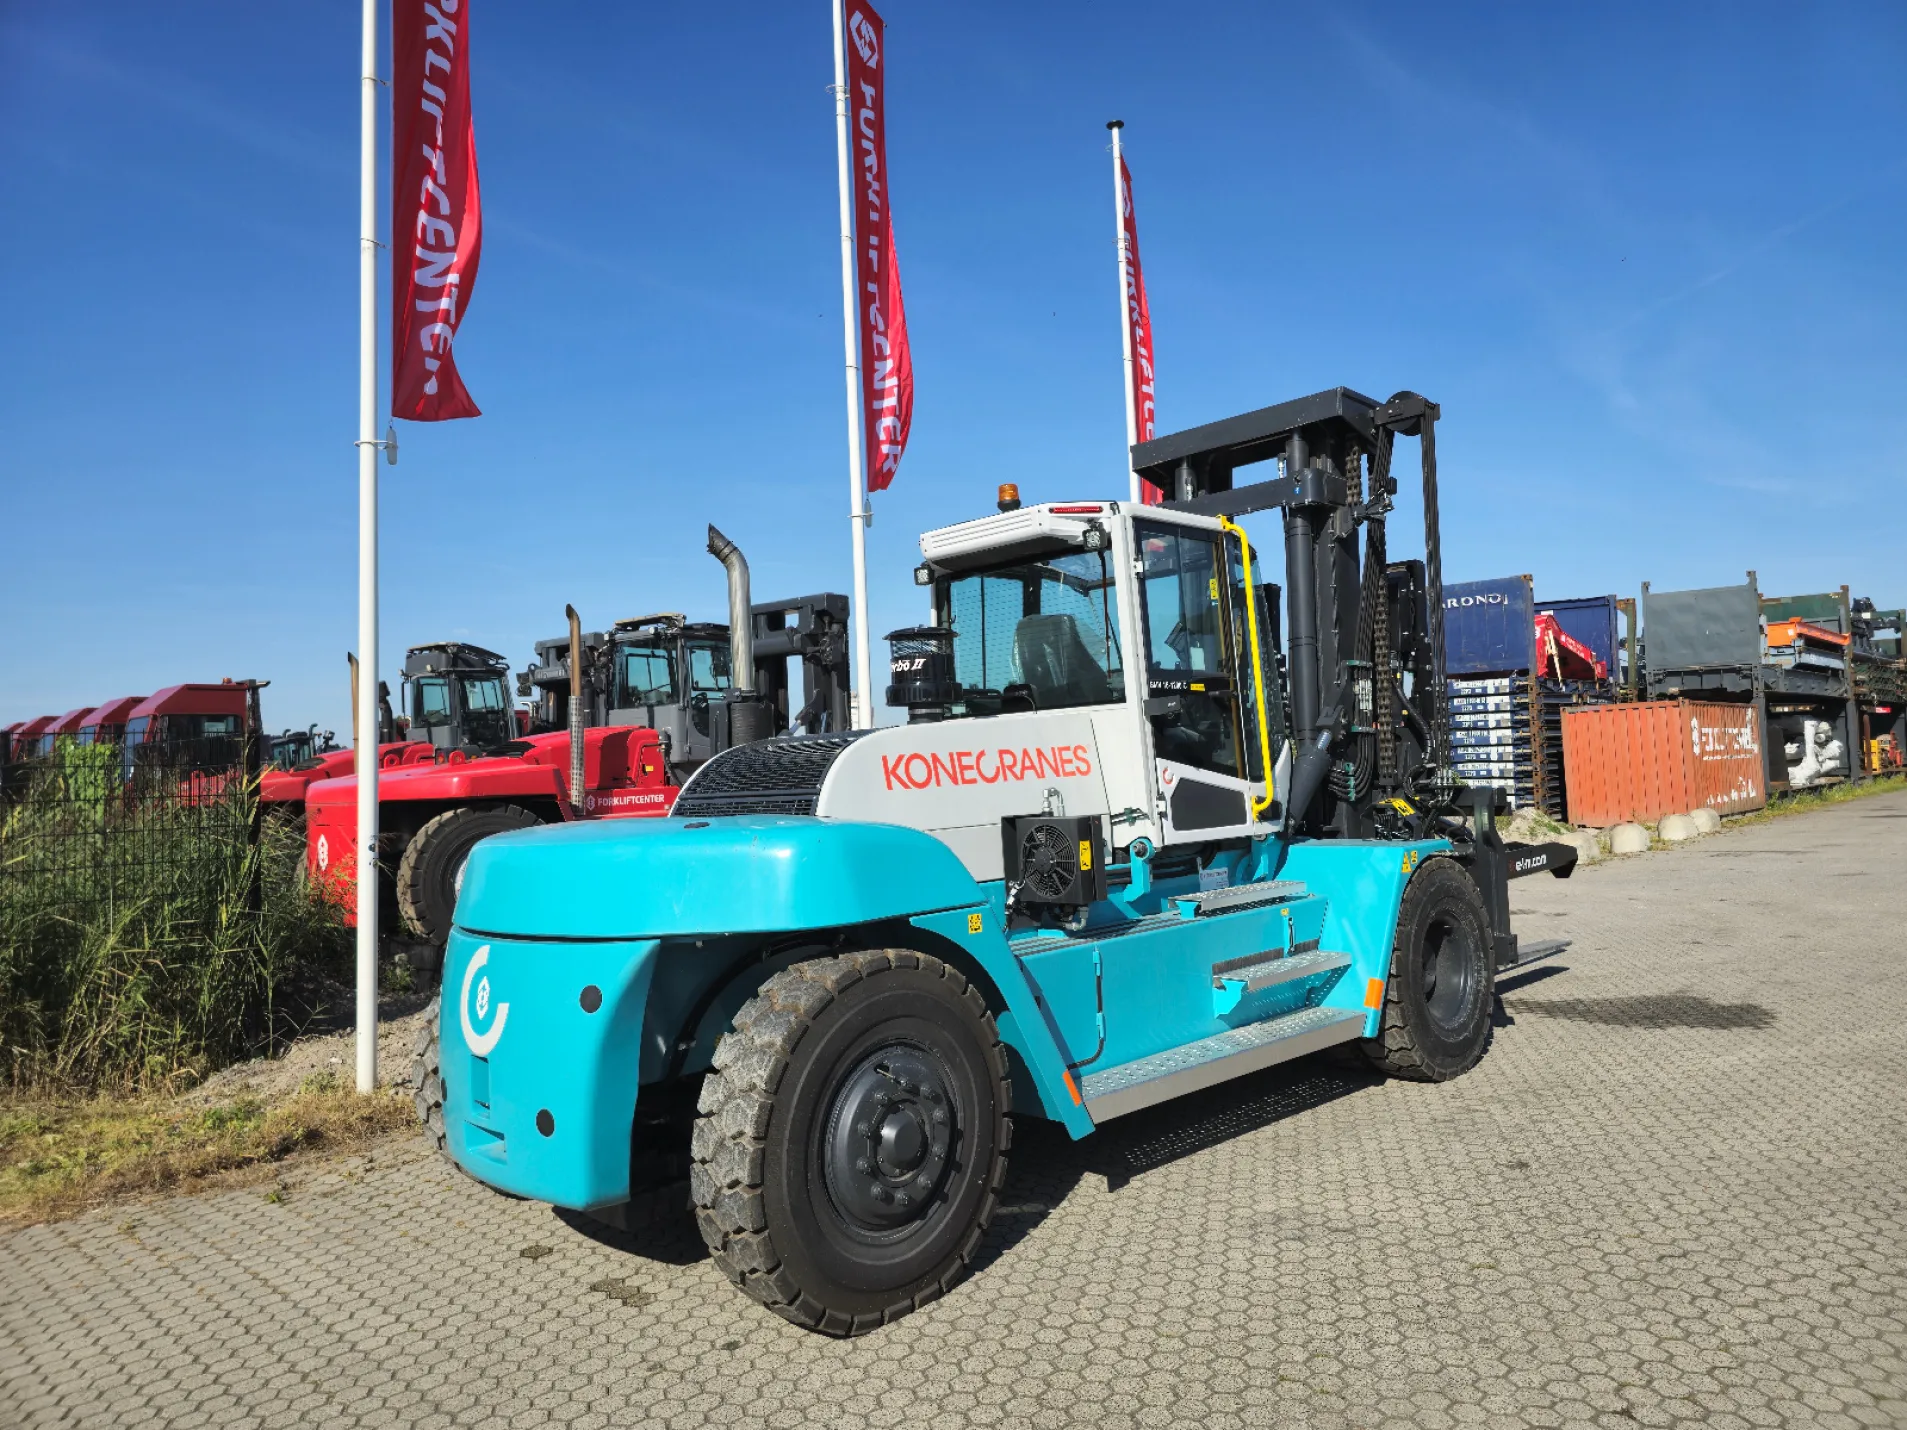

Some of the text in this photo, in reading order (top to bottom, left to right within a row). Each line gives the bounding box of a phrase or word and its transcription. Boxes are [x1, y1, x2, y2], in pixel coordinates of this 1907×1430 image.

[1442, 593, 1509, 609] RONO
[881, 744, 1092, 791] KONECRANES
[597, 794, 665, 807] FORKLIFTCENTER
